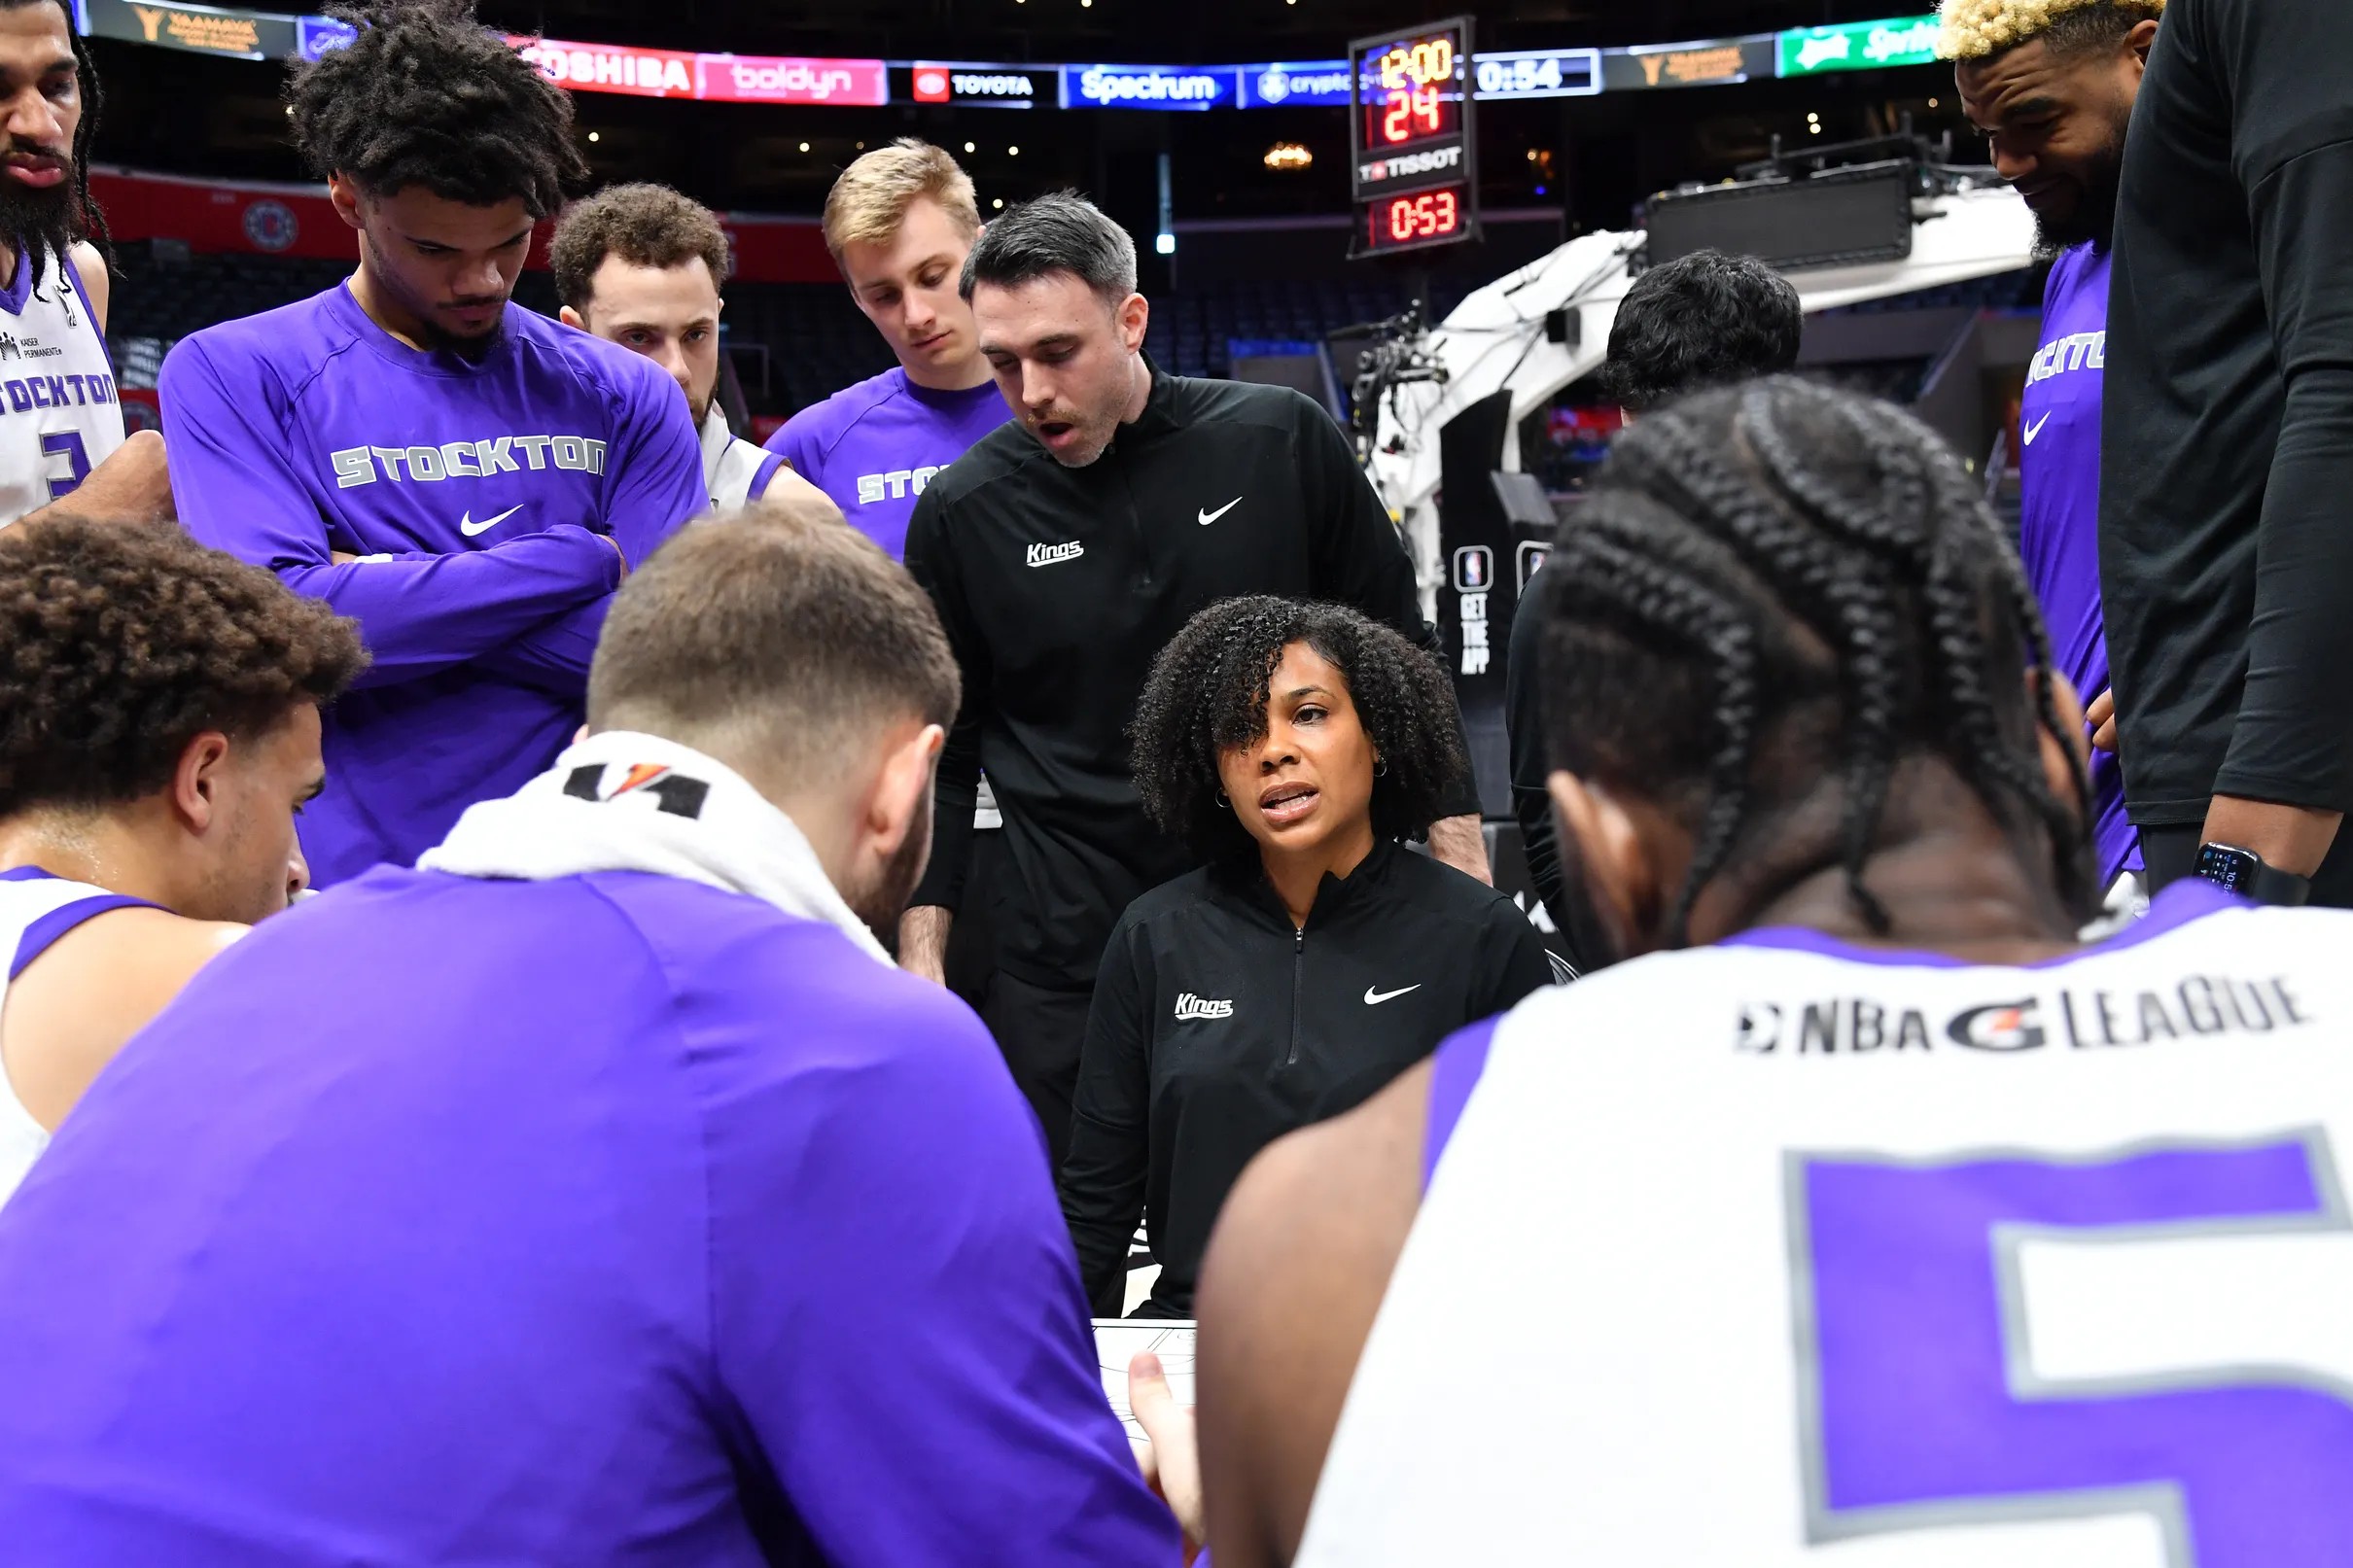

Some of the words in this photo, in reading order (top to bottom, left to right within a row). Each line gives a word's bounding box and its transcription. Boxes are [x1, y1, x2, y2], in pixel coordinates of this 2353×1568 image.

[730, 62, 852, 99] boldyn
[1381, 39, 1453, 89] 12:00
[1477, 59, 1563, 92] 0:54
[951, 74, 1034, 95] TOYOTA
[1080, 69, 1215, 105] Spectrum
[1385, 87, 1439, 142] 24
[1385, 146, 1462, 178] TISSOT
[1391, 192, 1456, 240] 0:53
[20, 337, 39, 347] KAISER
[0, 373, 117, 416] OCKTON
[331, 435, 607, 488] STOCKTON
[857, 465, 951, 505] STO
[1026, 540, 1084, 568] Kings
[1174, 993, 1234, 1020] Kings
[1800, 997, 1932, 1053] NBA
[2059, 973, 2309, 1049] LEAGUE
[1780, 1122, 2353, 1568] 5
